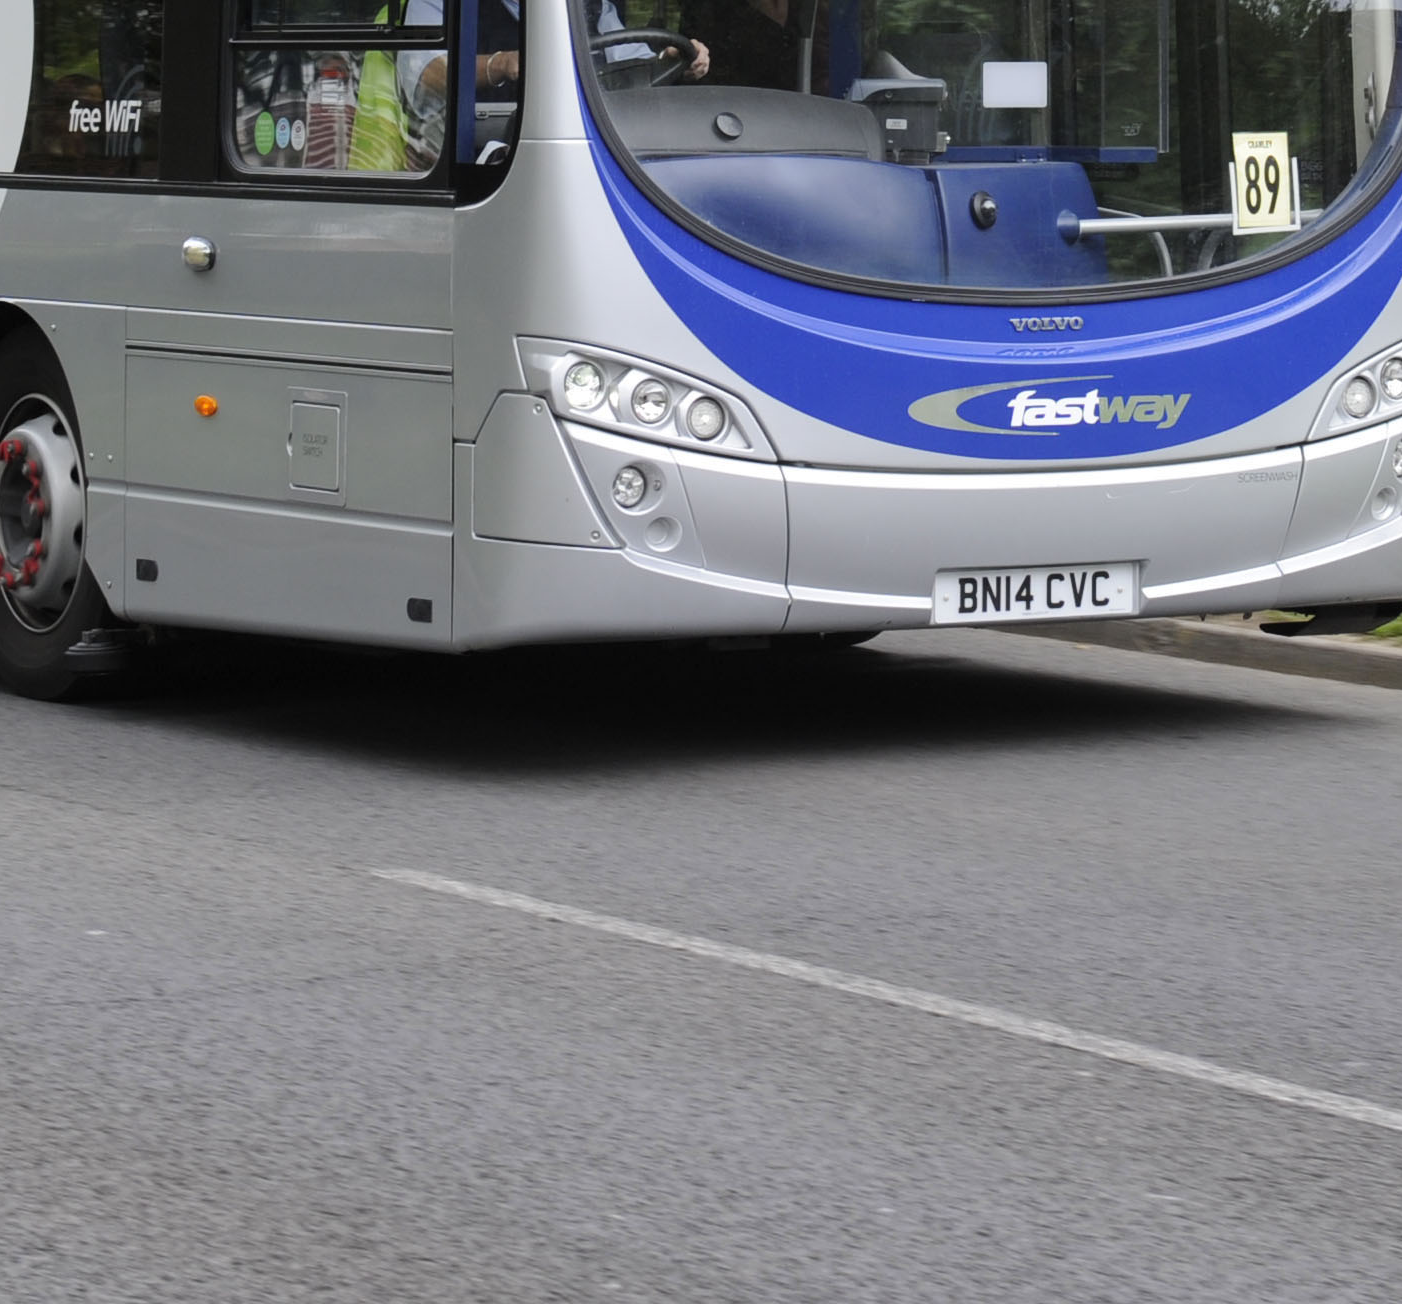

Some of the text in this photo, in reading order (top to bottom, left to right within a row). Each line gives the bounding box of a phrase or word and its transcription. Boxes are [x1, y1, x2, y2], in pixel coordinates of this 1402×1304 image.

[68, 99, 142, 133] free WiFi
[1245, 155, 1280, 214] 89
[1008, 316, 1084, 332] VOLVO
[1007, 389, 1191, 430] fastway
[958, 570, 1110, 614] BN14 CVC
